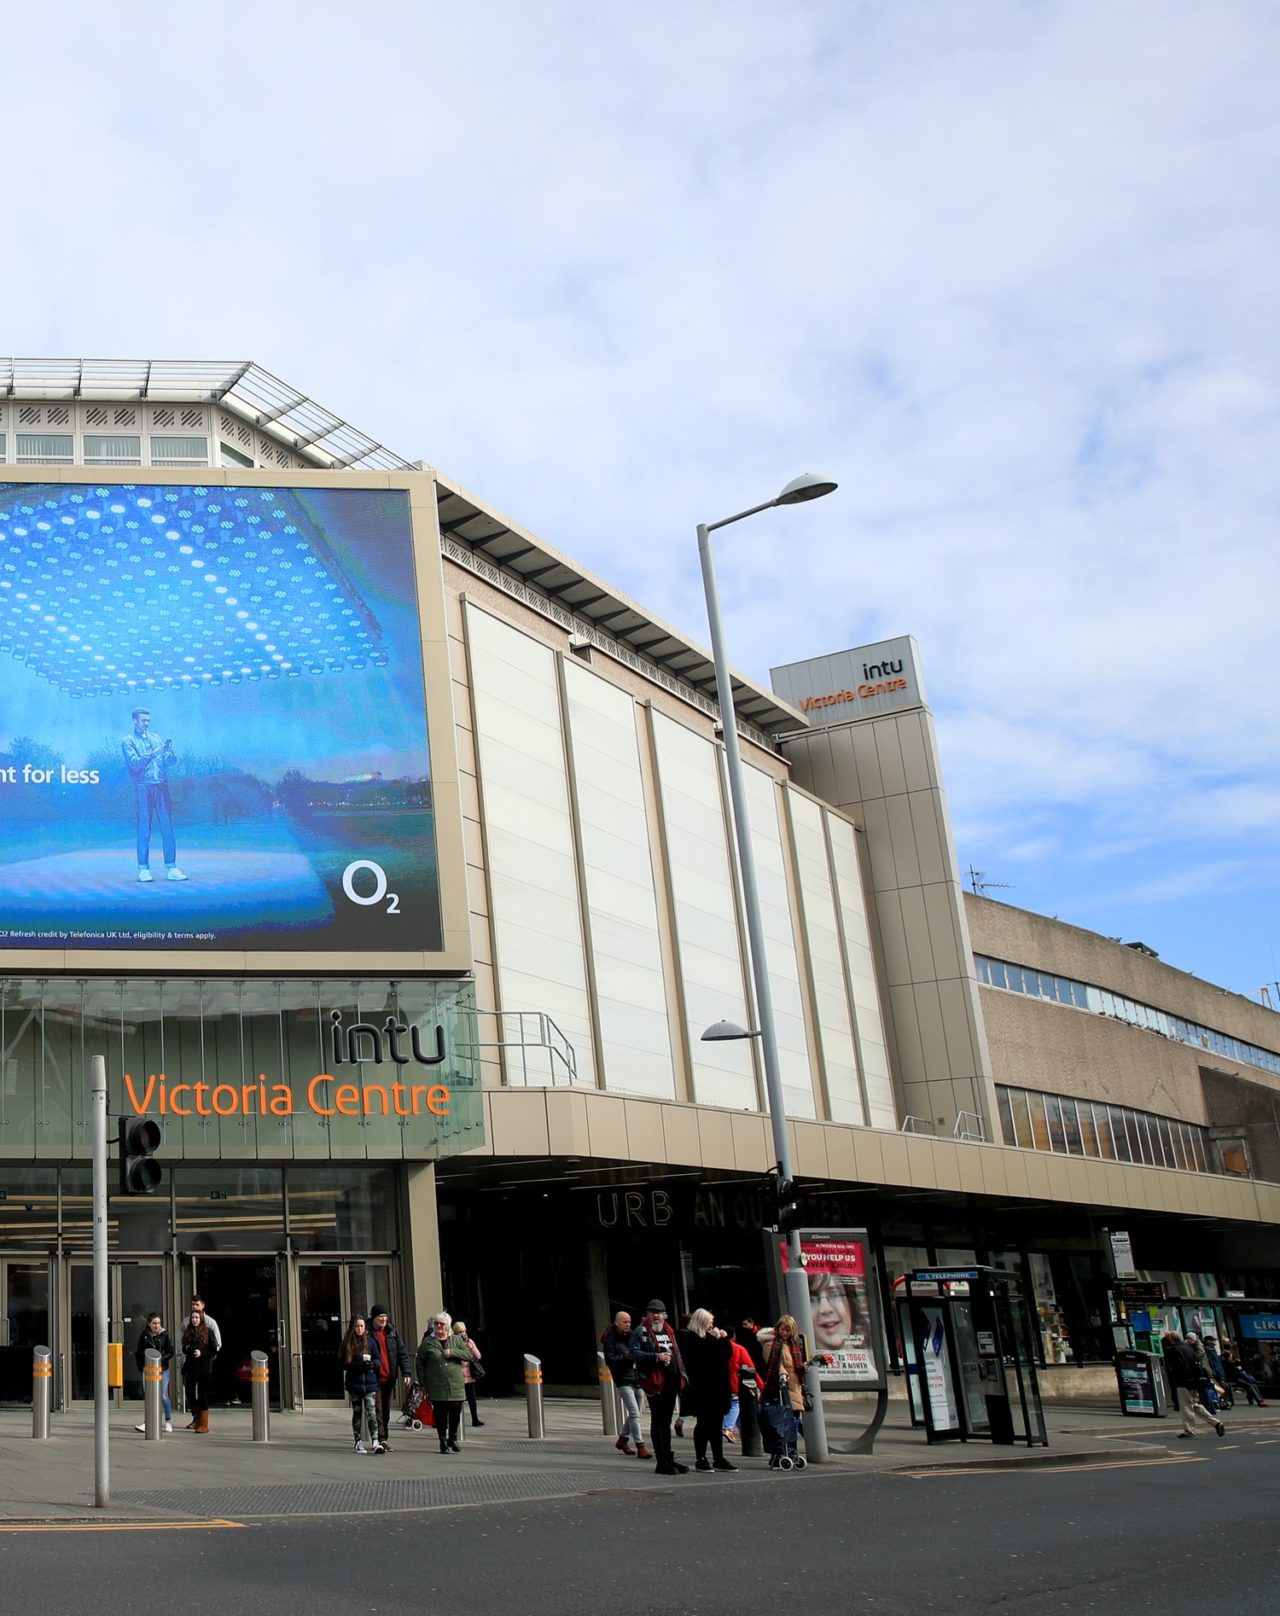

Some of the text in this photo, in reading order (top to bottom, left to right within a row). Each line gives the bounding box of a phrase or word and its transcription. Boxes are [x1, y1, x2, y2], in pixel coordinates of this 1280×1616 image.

[863, 659, 903, 681] intu
[799, 677, 907, 711] Victoria Centre
[22, 763, 55, 784] for
[60, 764, 100, 785] less
[10, 930, 37, 938] Refresh
[37, 930, 58, 938] credit
[59, 931, 68, 939] by
[133, 931, 165, 940] eligibility
[195, 932, 216, 940] apply.
[331, 1010, 446, 1065] intu
[124, 1074, 452, 1116] Victoria Centre
[823, 1254, 844, 1262] HELP
[845, 1255, 856, 1263] US
